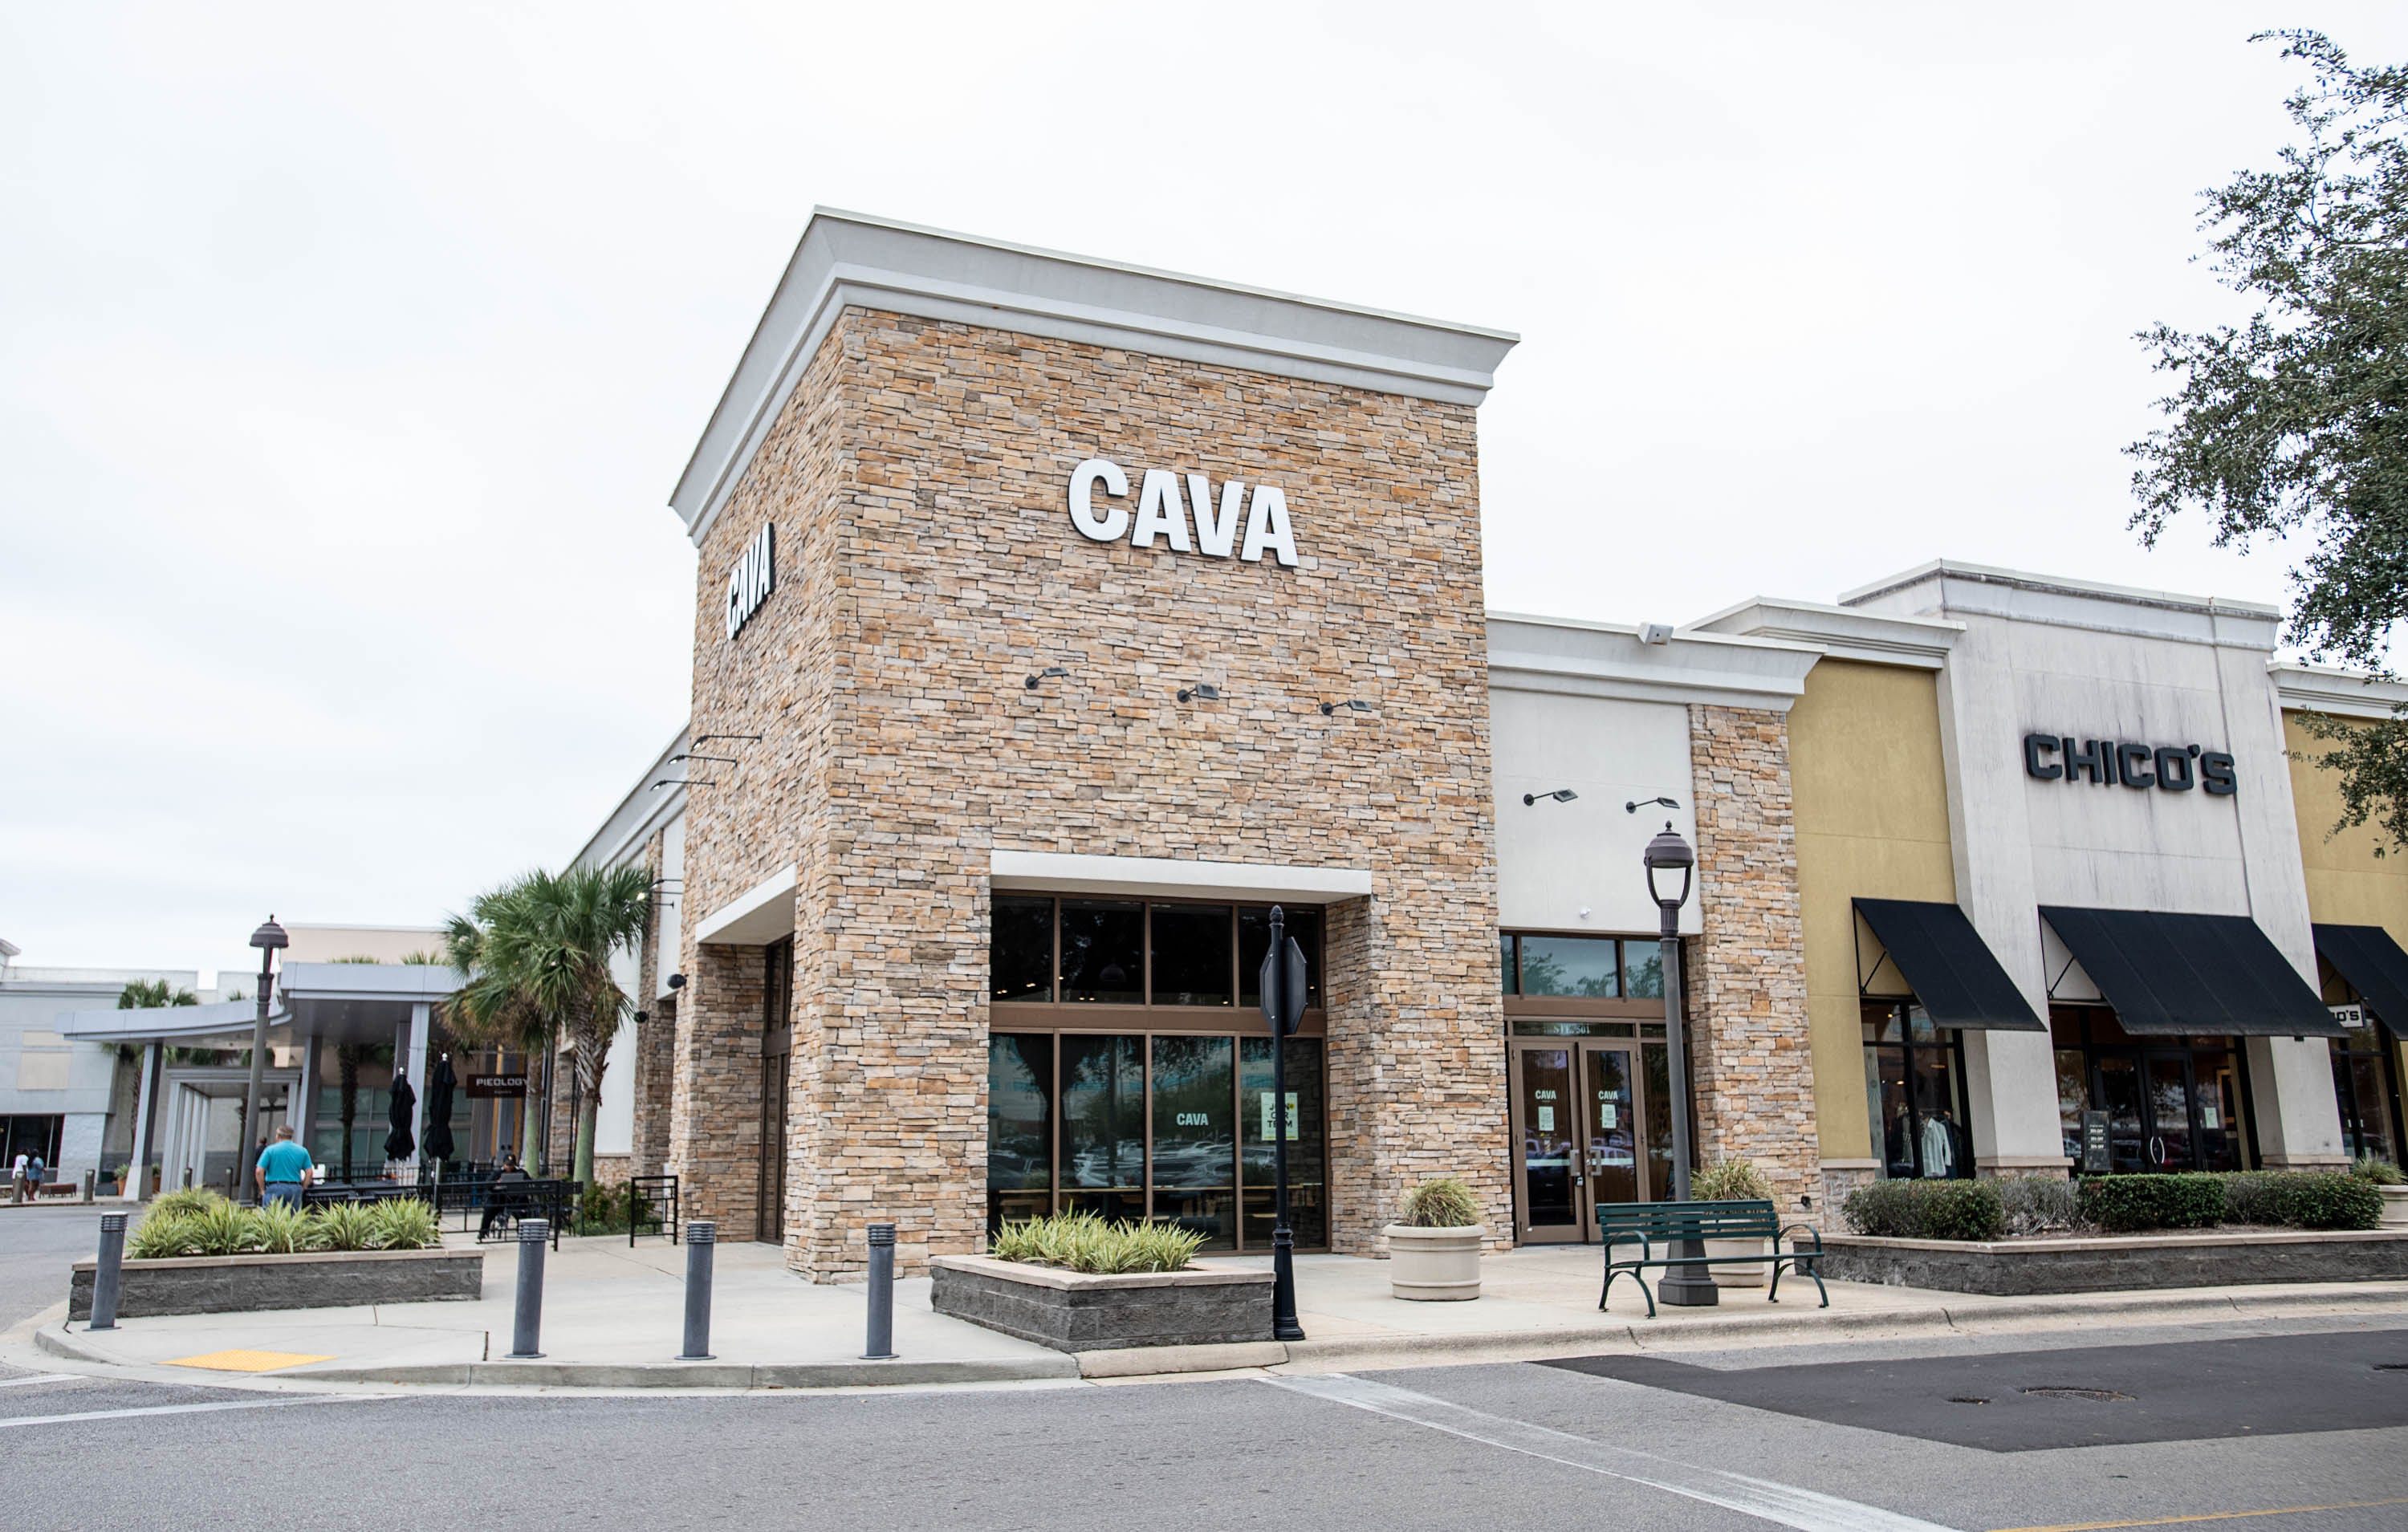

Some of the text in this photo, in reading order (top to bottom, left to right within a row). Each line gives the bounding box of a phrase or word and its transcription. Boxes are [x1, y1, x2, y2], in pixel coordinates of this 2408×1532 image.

[1068, 458, 1299, 567] CAVA
[726, 522, 773, 640] CAVA
[2024, 733, 2237, 794] CHICO'S
[1535, 1090, 1557, 1100] CAVA
[1598, 1090, 1619, 1100] CAVA
[1269, 1103, 1290, 1111] JN
[1176, 1112, 1209, 1126] CAVA
[1271, 1111, 1289, 1120] OR
[1267, 1120, 1292, 1128] TEM
